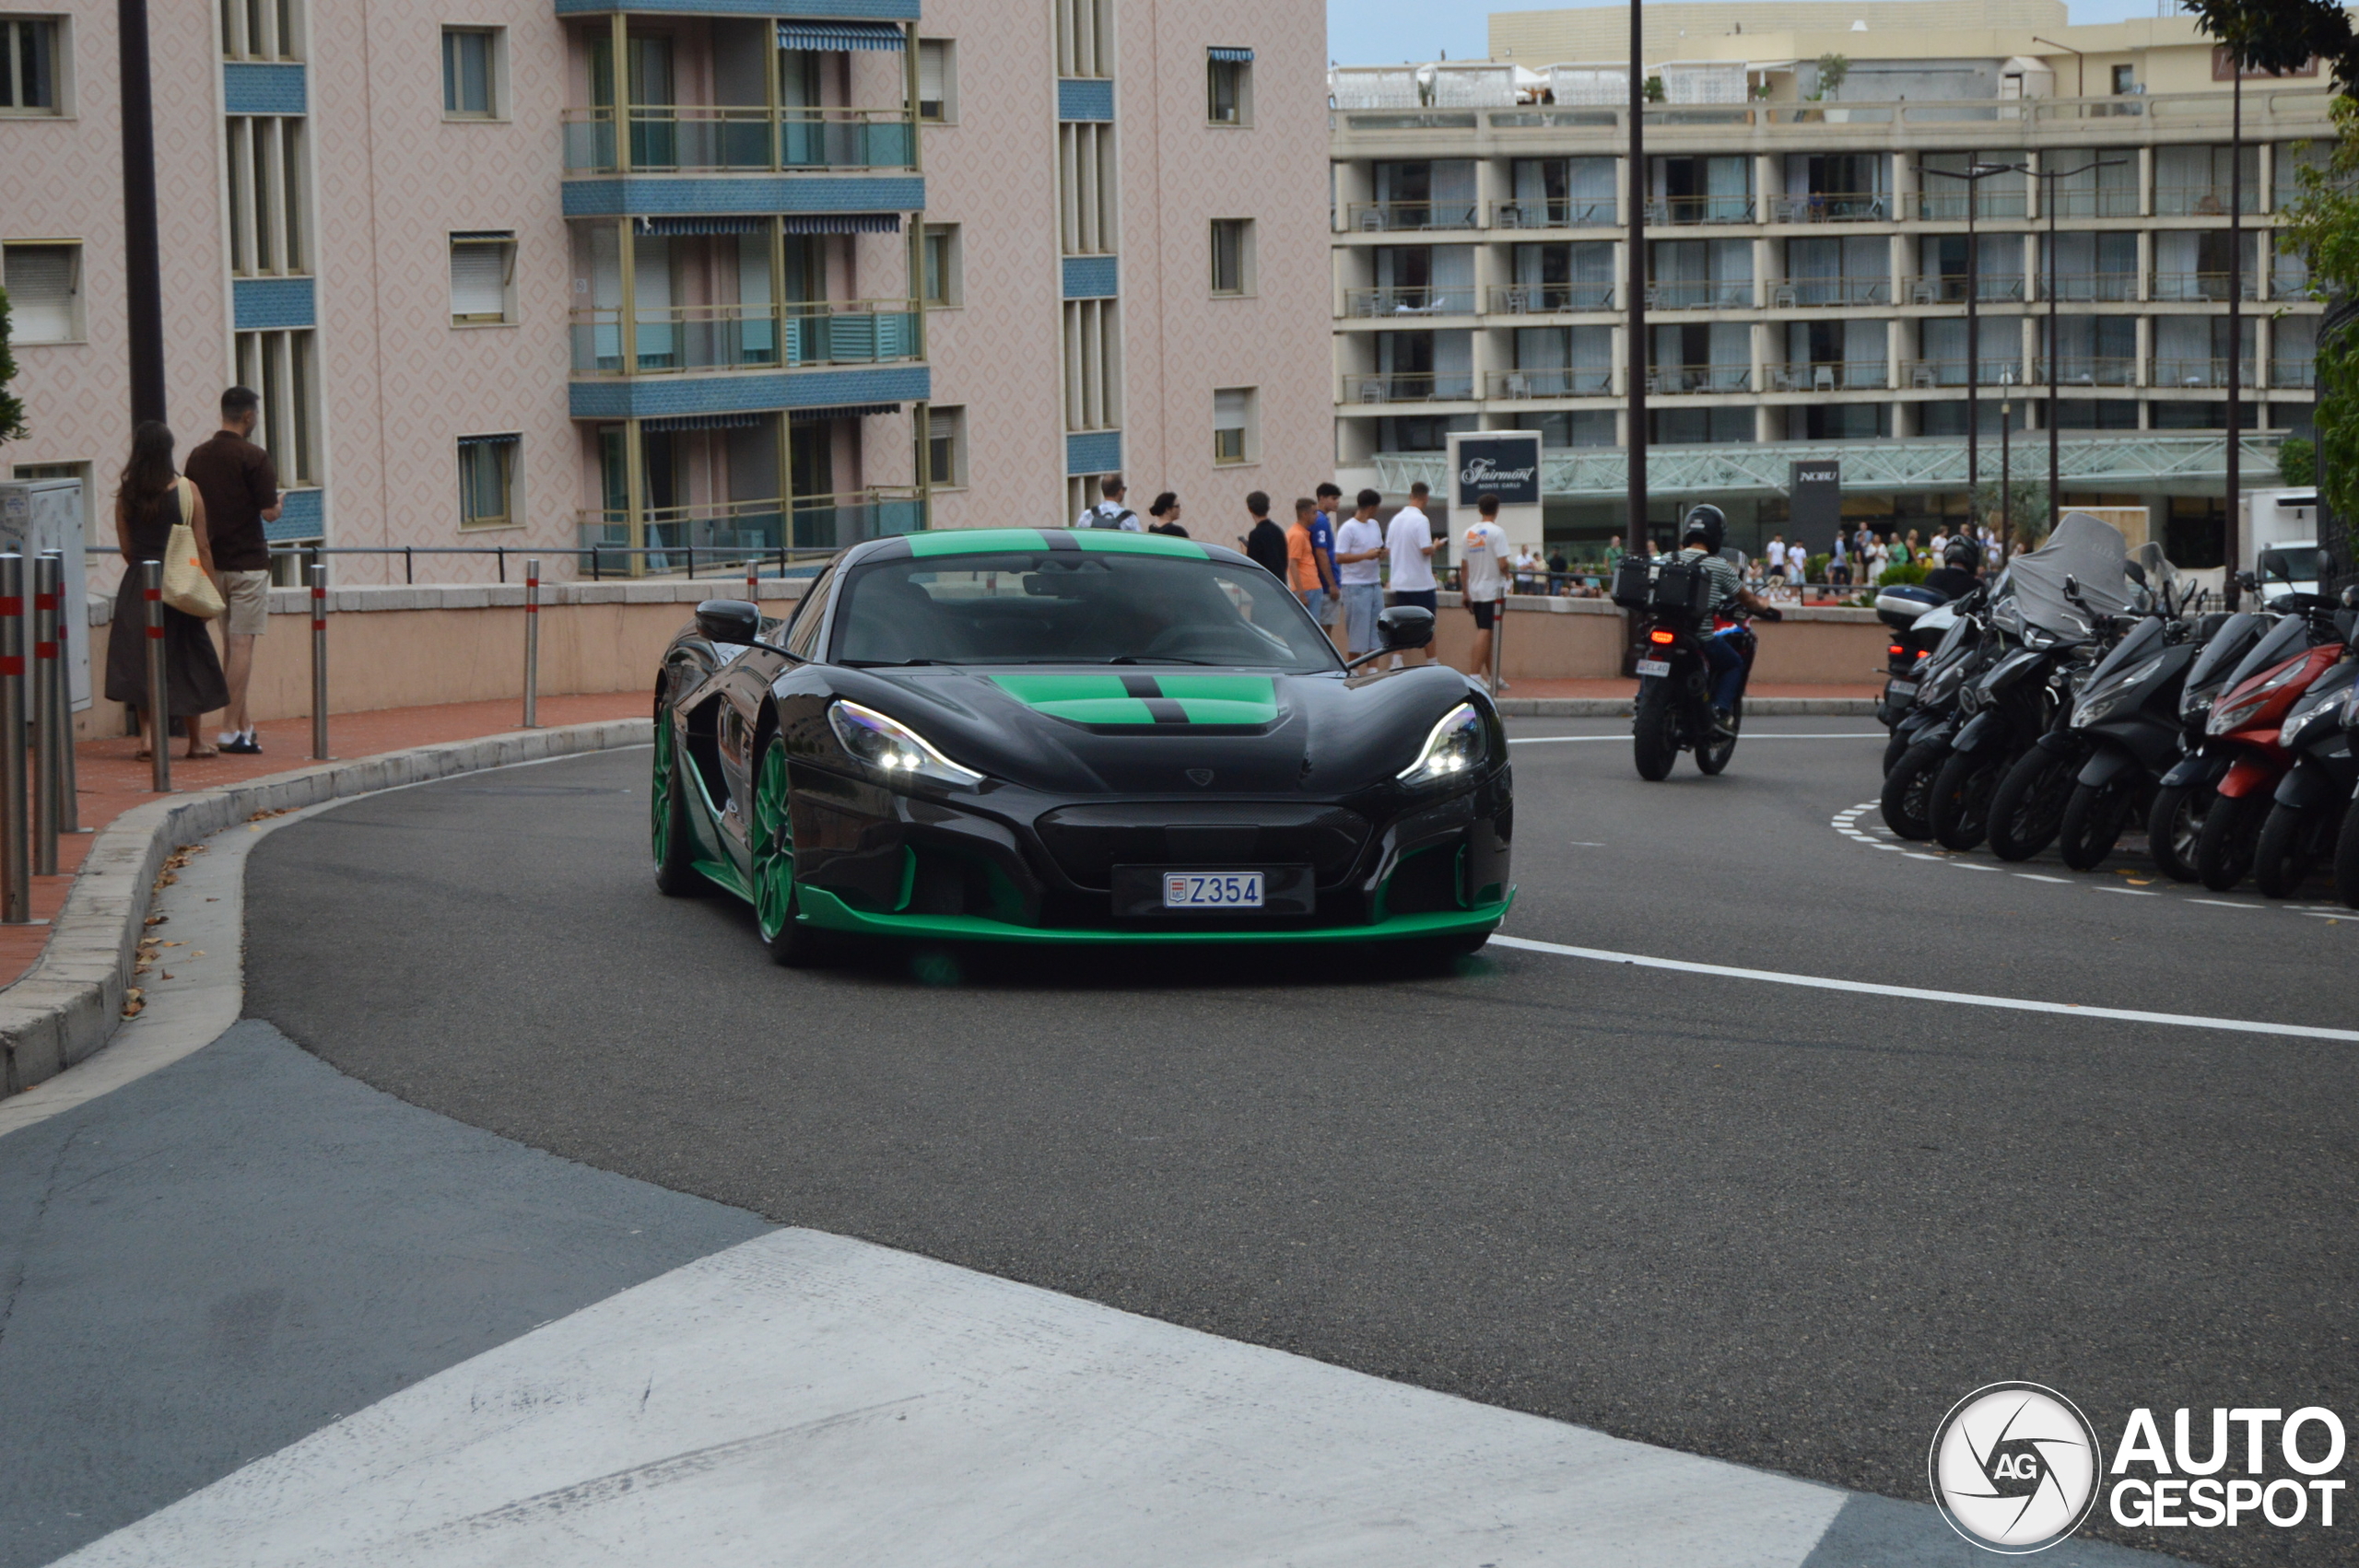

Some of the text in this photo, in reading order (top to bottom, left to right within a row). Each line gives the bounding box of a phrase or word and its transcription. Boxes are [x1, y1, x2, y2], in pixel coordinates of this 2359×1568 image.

[1461, 458, 1535, 486] Fairmont
[1799, 471, 1837, 482] NOBU
[1318, 530, 1326, 544] 3
[1172, 891, 1184, 899] MC
[1190, 877, 1259, 903] Z354
